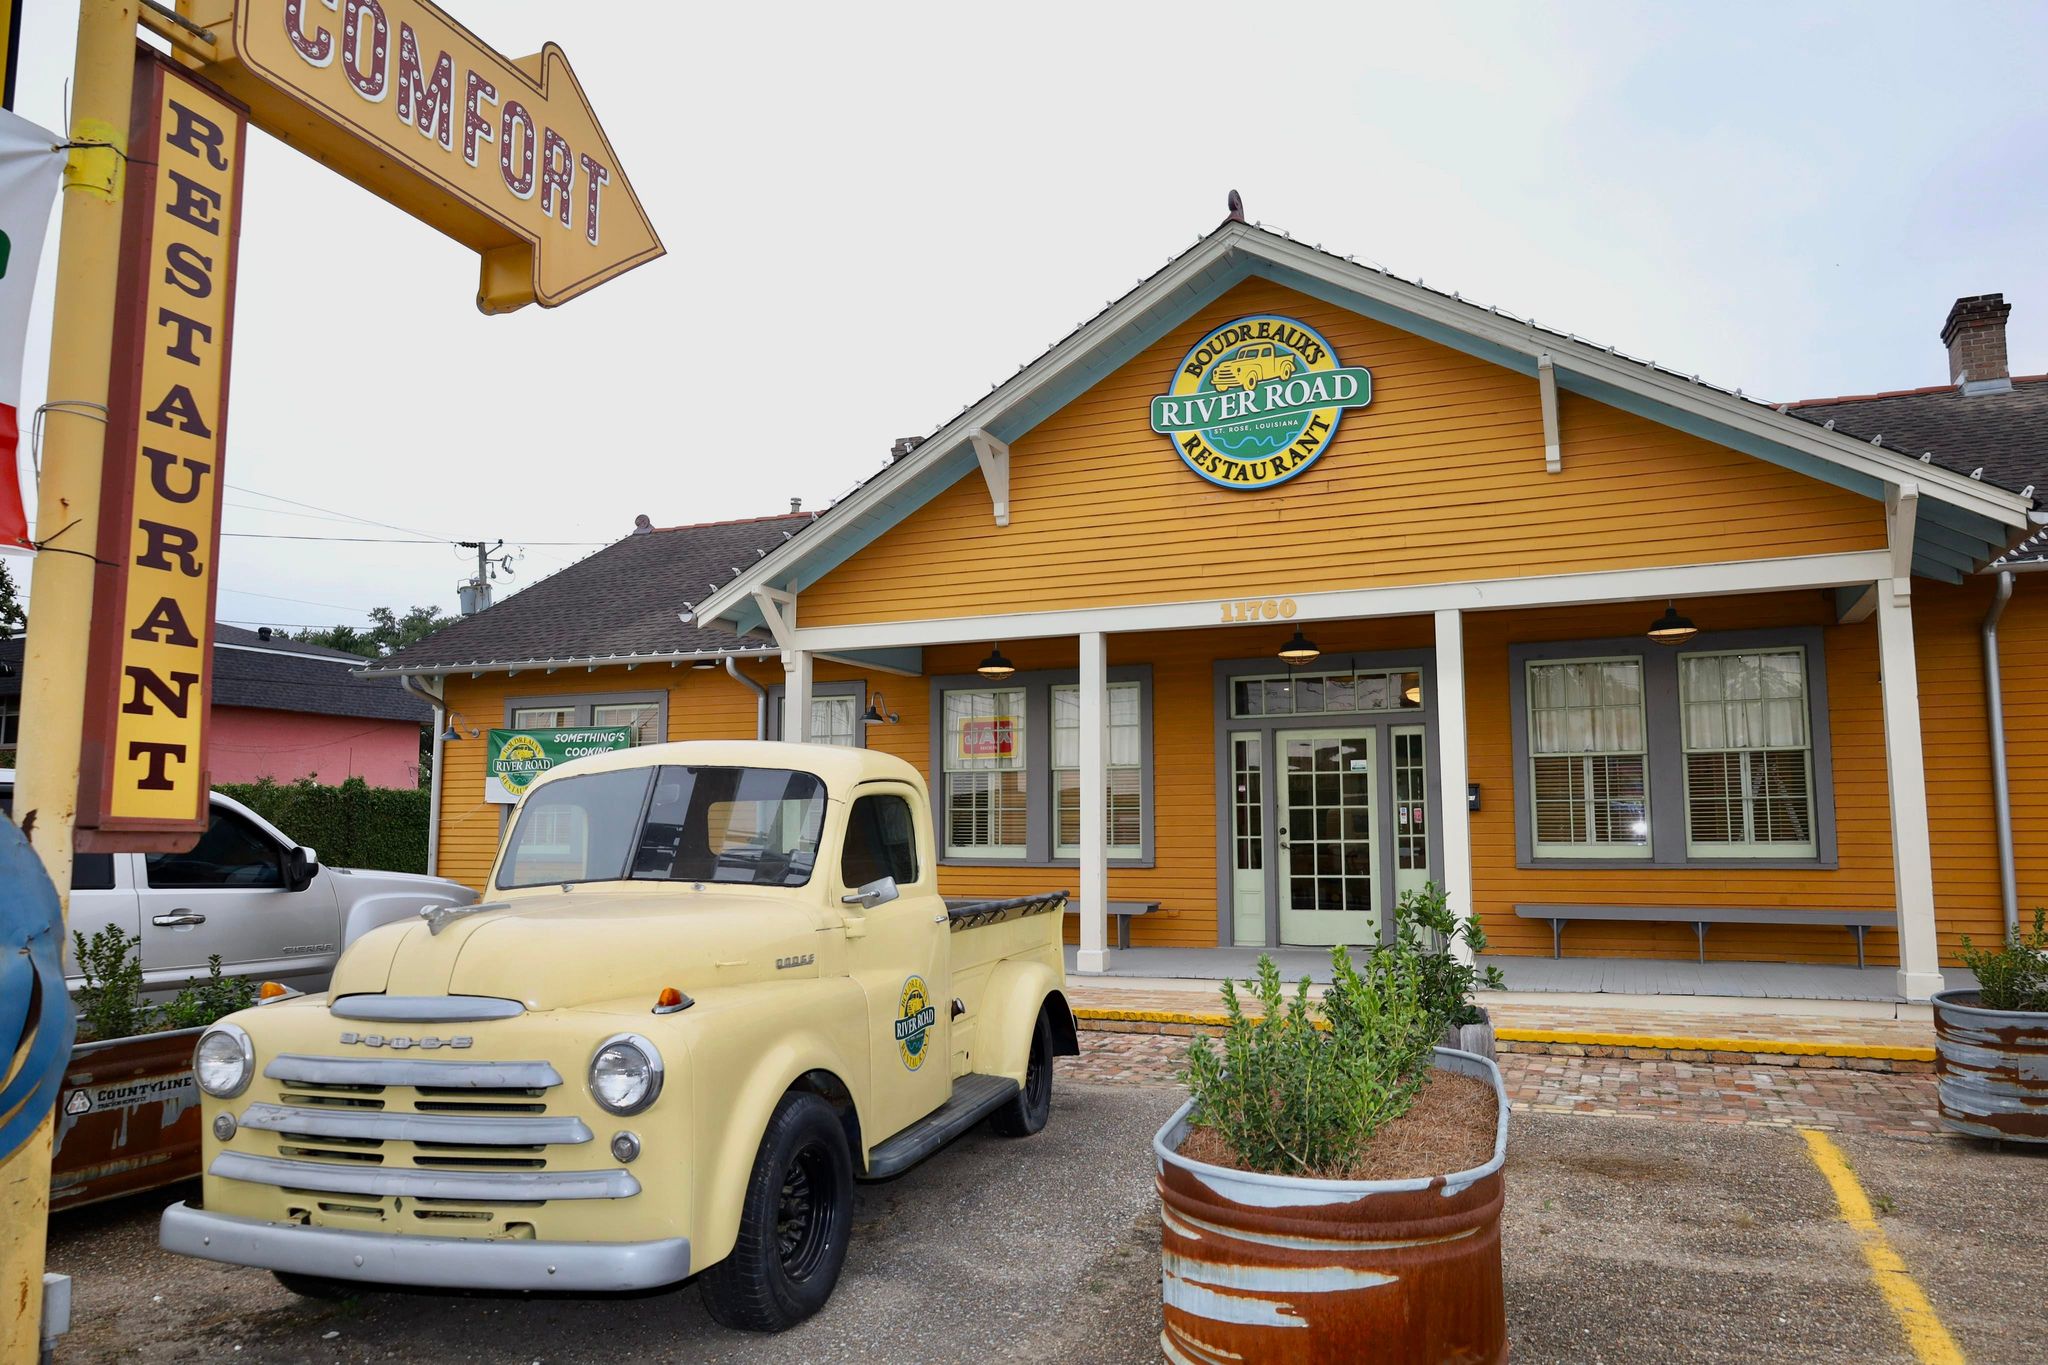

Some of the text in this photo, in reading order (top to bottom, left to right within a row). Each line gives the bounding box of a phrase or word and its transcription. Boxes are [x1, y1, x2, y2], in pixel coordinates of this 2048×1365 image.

[282, 0, 609, 246] COMFORT
[1184, 321, 1326, 379] BOUDREAUX'S
[1160, 373, 1359, 427] RIVER ROAD
[1228, 424, 1252, 433] ROSE,
[1255, 419, 1299, 430] LOUISIANA
[121, 98, 229, 791] RESTAURANT
[1181, 413, 1331, 482] RESTAURANT
[1220, 597, 1298, 623] 11760
[553, 731, 626, 744] SOMETHING'S
[496, 759, 551, 772] RIVER ROAD
[775, 952, 816, 970] DODGE
[896, 1008, 935, 1038] RIVER ROAD
[97, 1076, 192, 1102] COUNTYLINE
